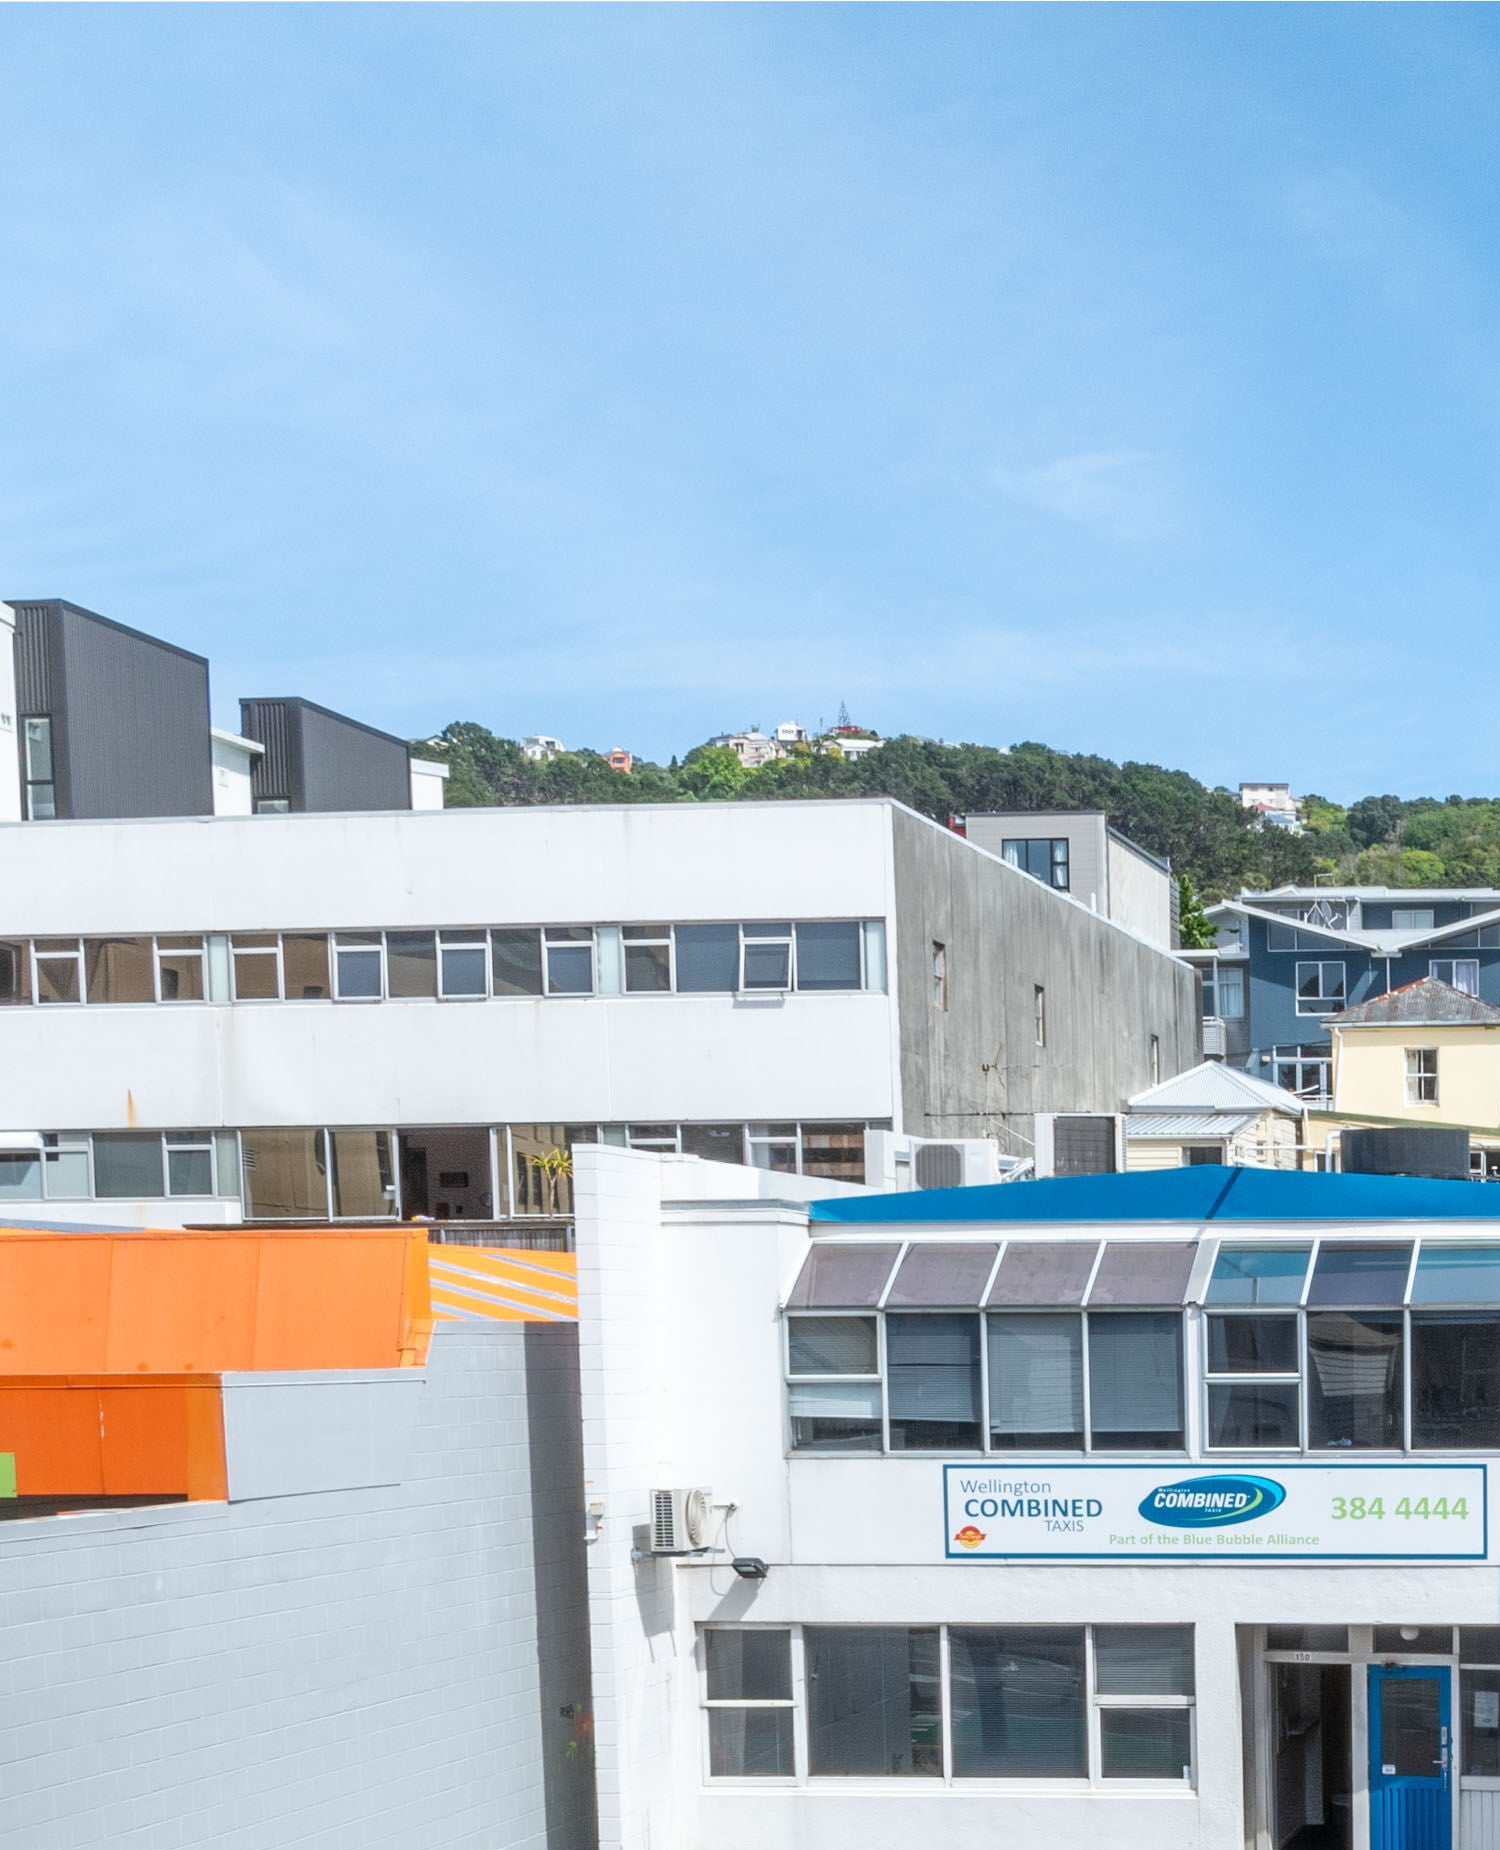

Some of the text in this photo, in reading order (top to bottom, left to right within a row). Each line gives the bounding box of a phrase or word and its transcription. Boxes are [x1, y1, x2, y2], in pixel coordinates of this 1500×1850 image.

[960, 1479, 1052, 1497] Wellington
[964, 1498, 1103, 1518] COMBINED
[1154, 1493, 1247, 1508] COMBINED
[1331, 1496, 1470, 1520] 384 4444
[1044, 1519, 1085, 1532] TAXIS
[1108, 1534, 1320, 1546] Part of the Blue Bubble Alliance
